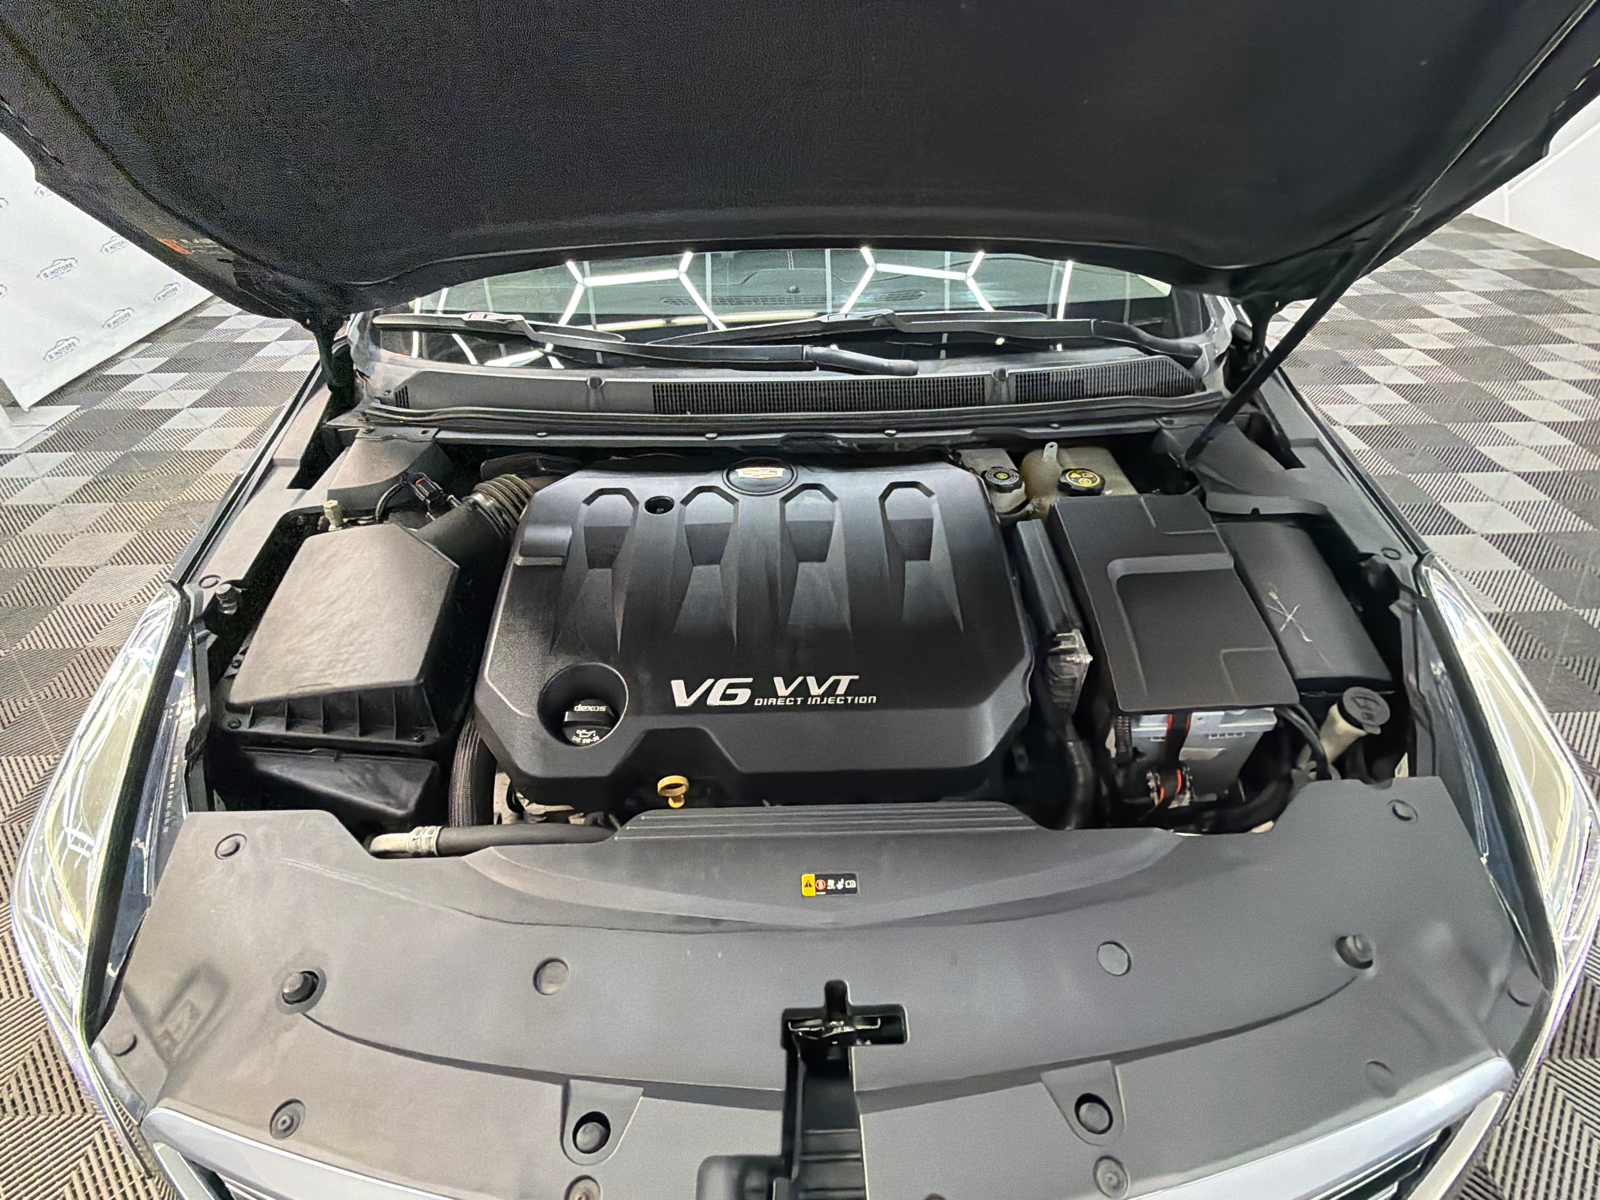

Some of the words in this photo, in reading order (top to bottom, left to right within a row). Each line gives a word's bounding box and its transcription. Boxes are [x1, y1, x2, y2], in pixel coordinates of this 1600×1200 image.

[671, 678, 753, 708] V6
[773, 675, 859, 696] VVT
[754, 697, 804, 706] DIRECT
[807, 696, 877, 705] INJECTION
[573, 704, 608, 712] dexos
